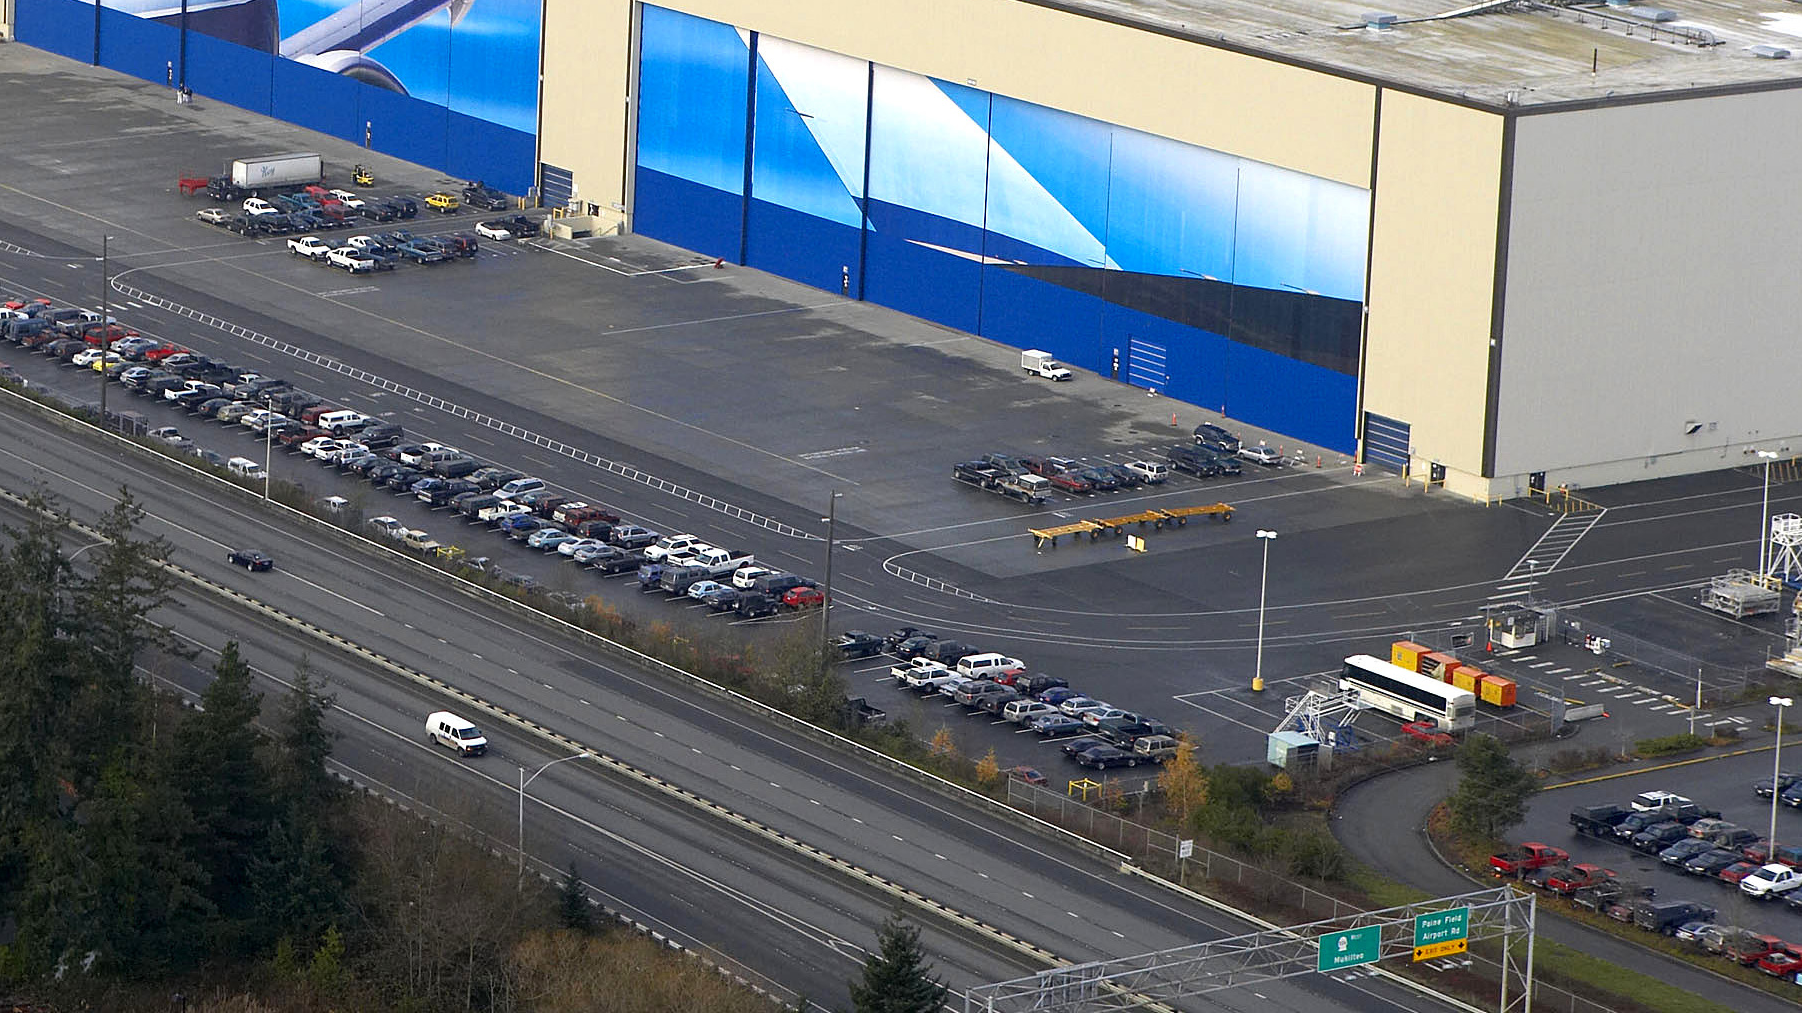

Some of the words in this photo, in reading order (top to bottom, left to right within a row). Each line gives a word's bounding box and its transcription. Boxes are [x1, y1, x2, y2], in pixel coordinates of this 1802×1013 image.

[1421, 919, 1441, 928] Paine
[1444, 914, 1462, 924] Field
[1422, 929, 1448, 941] Airport
[1451, 926, 1460, 935] Rd
[1424, 947, 1438, 955] EXIT
[1440, 944, 1455, 952] ONLY
[1333, 952, 1364, 964] Mukilteo
